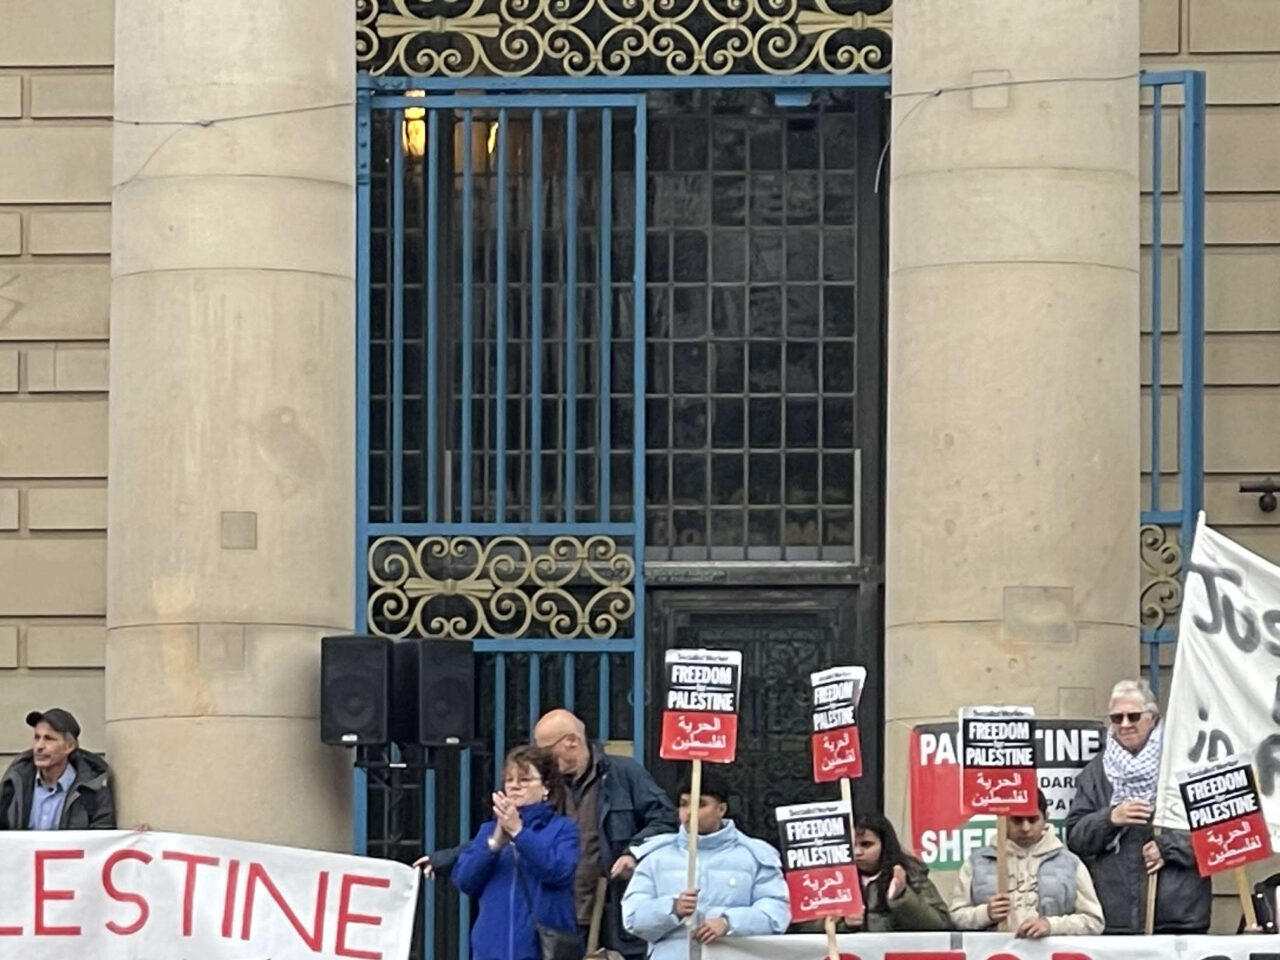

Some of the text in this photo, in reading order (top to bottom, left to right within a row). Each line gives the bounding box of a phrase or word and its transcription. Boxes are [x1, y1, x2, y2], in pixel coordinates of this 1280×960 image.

[672, 665, 732, 685] FREEDOM
[668, 690, 734, 711] PALESTINE
[969, 722, 1030, 739] FREEDOM
[920, 729, 1100, 766] PAINE
[966, 747, 1034, 766] PALESTINE
[1186, 769, 1248, 802] FREEDOM
[1189, 793, 1258, 829] PALESTINE
[786, 817, 845, 841] FREEDOM
[787, 844, 852, 869] PALESTINE
